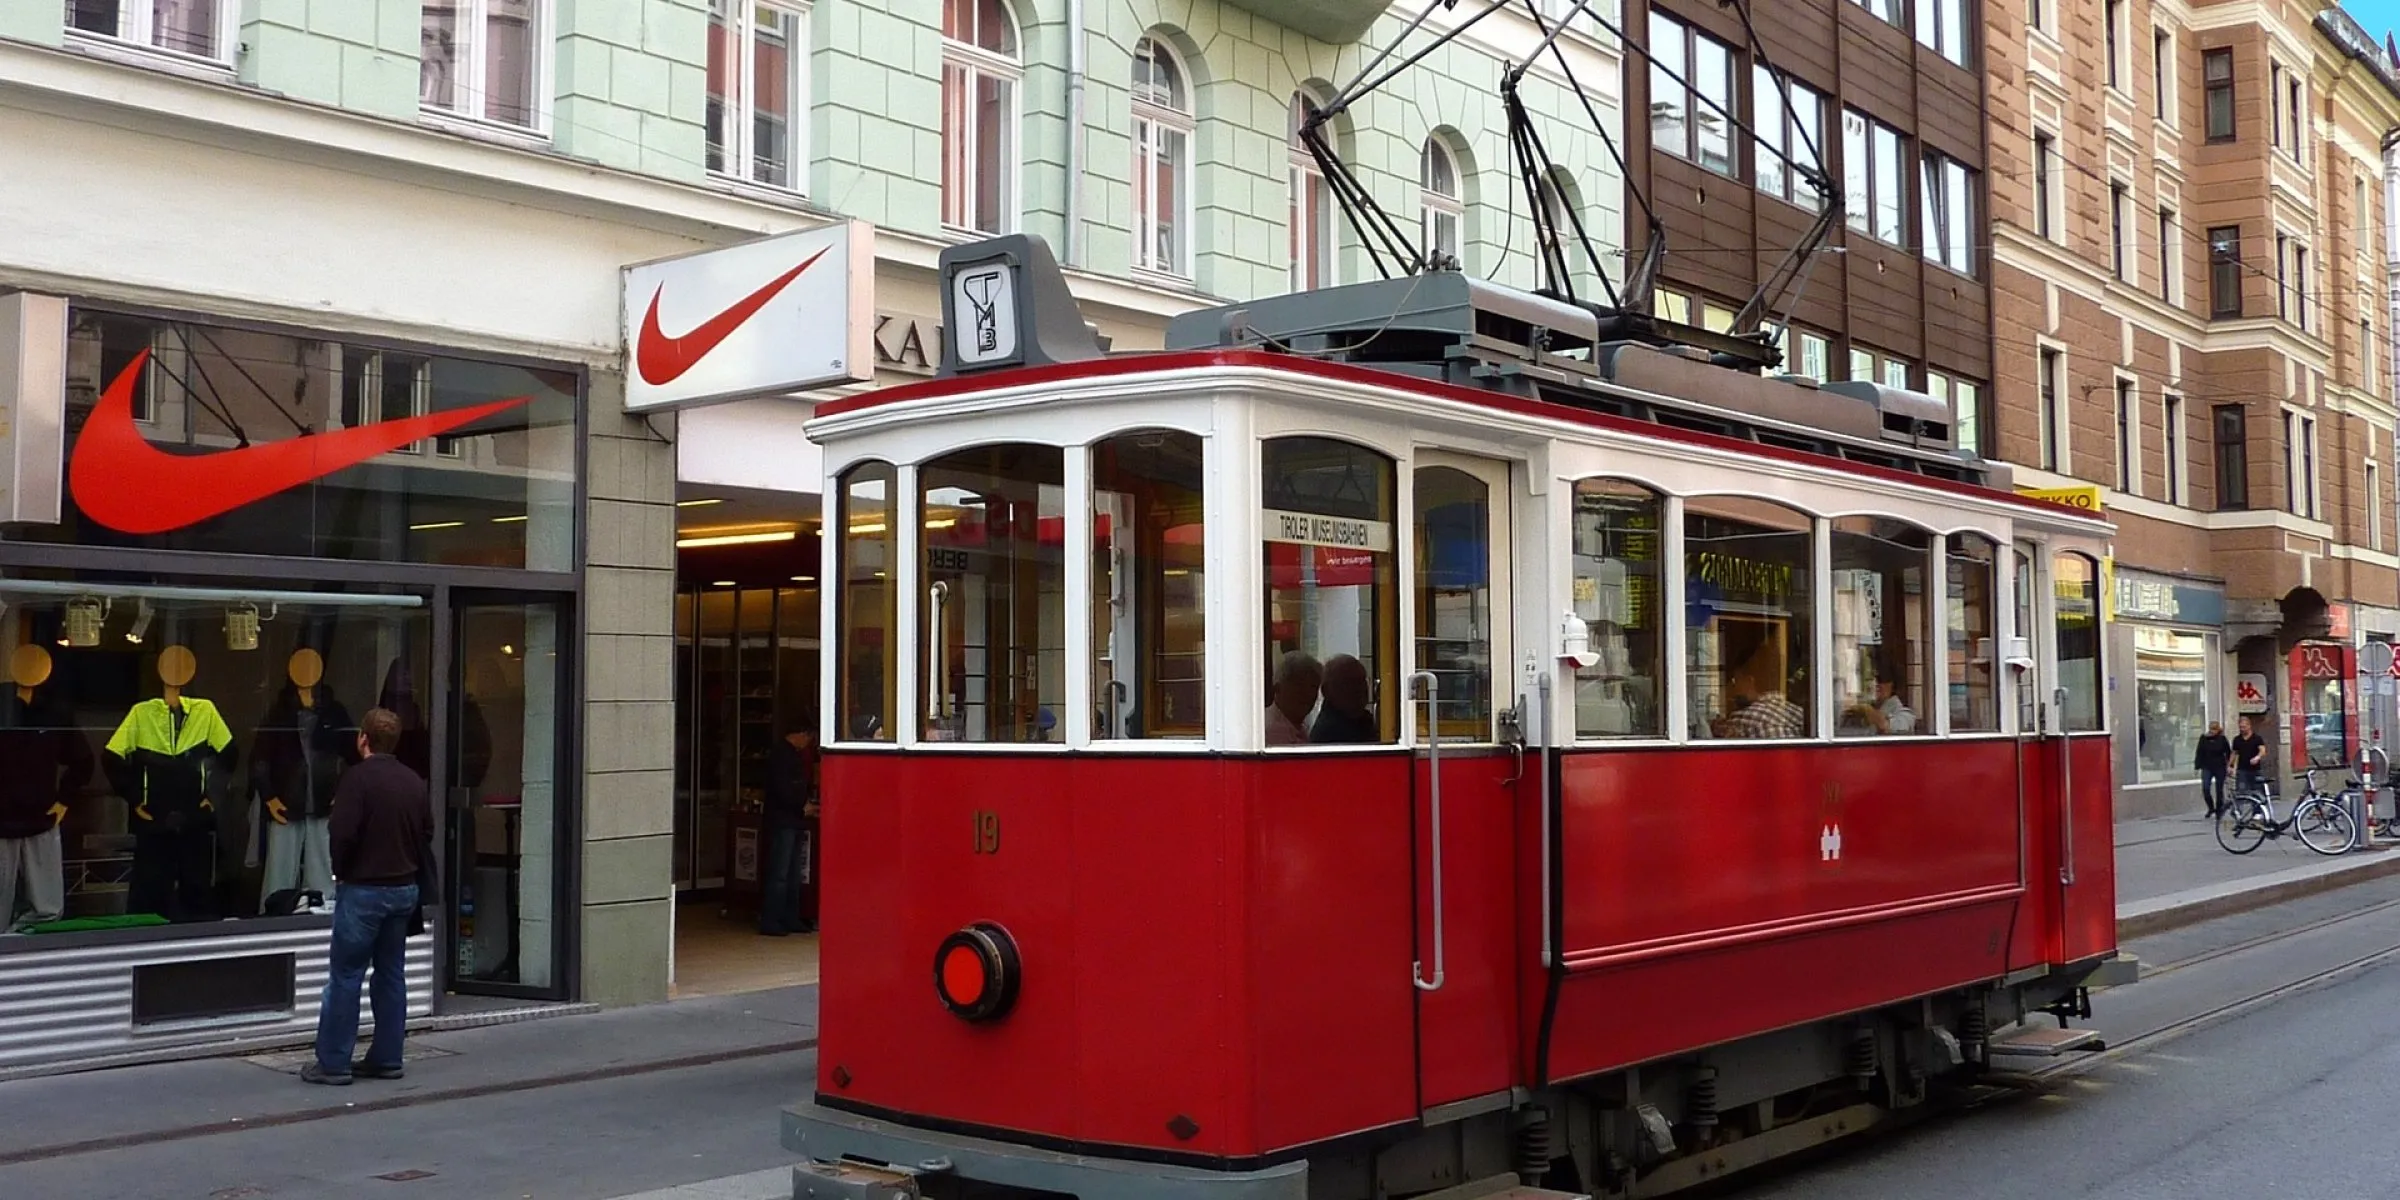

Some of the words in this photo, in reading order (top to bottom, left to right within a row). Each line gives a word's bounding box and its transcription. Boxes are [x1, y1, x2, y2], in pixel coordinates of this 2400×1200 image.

[874, 315, 944, 370] KA
[1280, 515, 1309, 540] TIROLER
[1311, 518, 1368, 546] MUSEUMSBAHNEN
[972, 810, 1000, 853] 19
